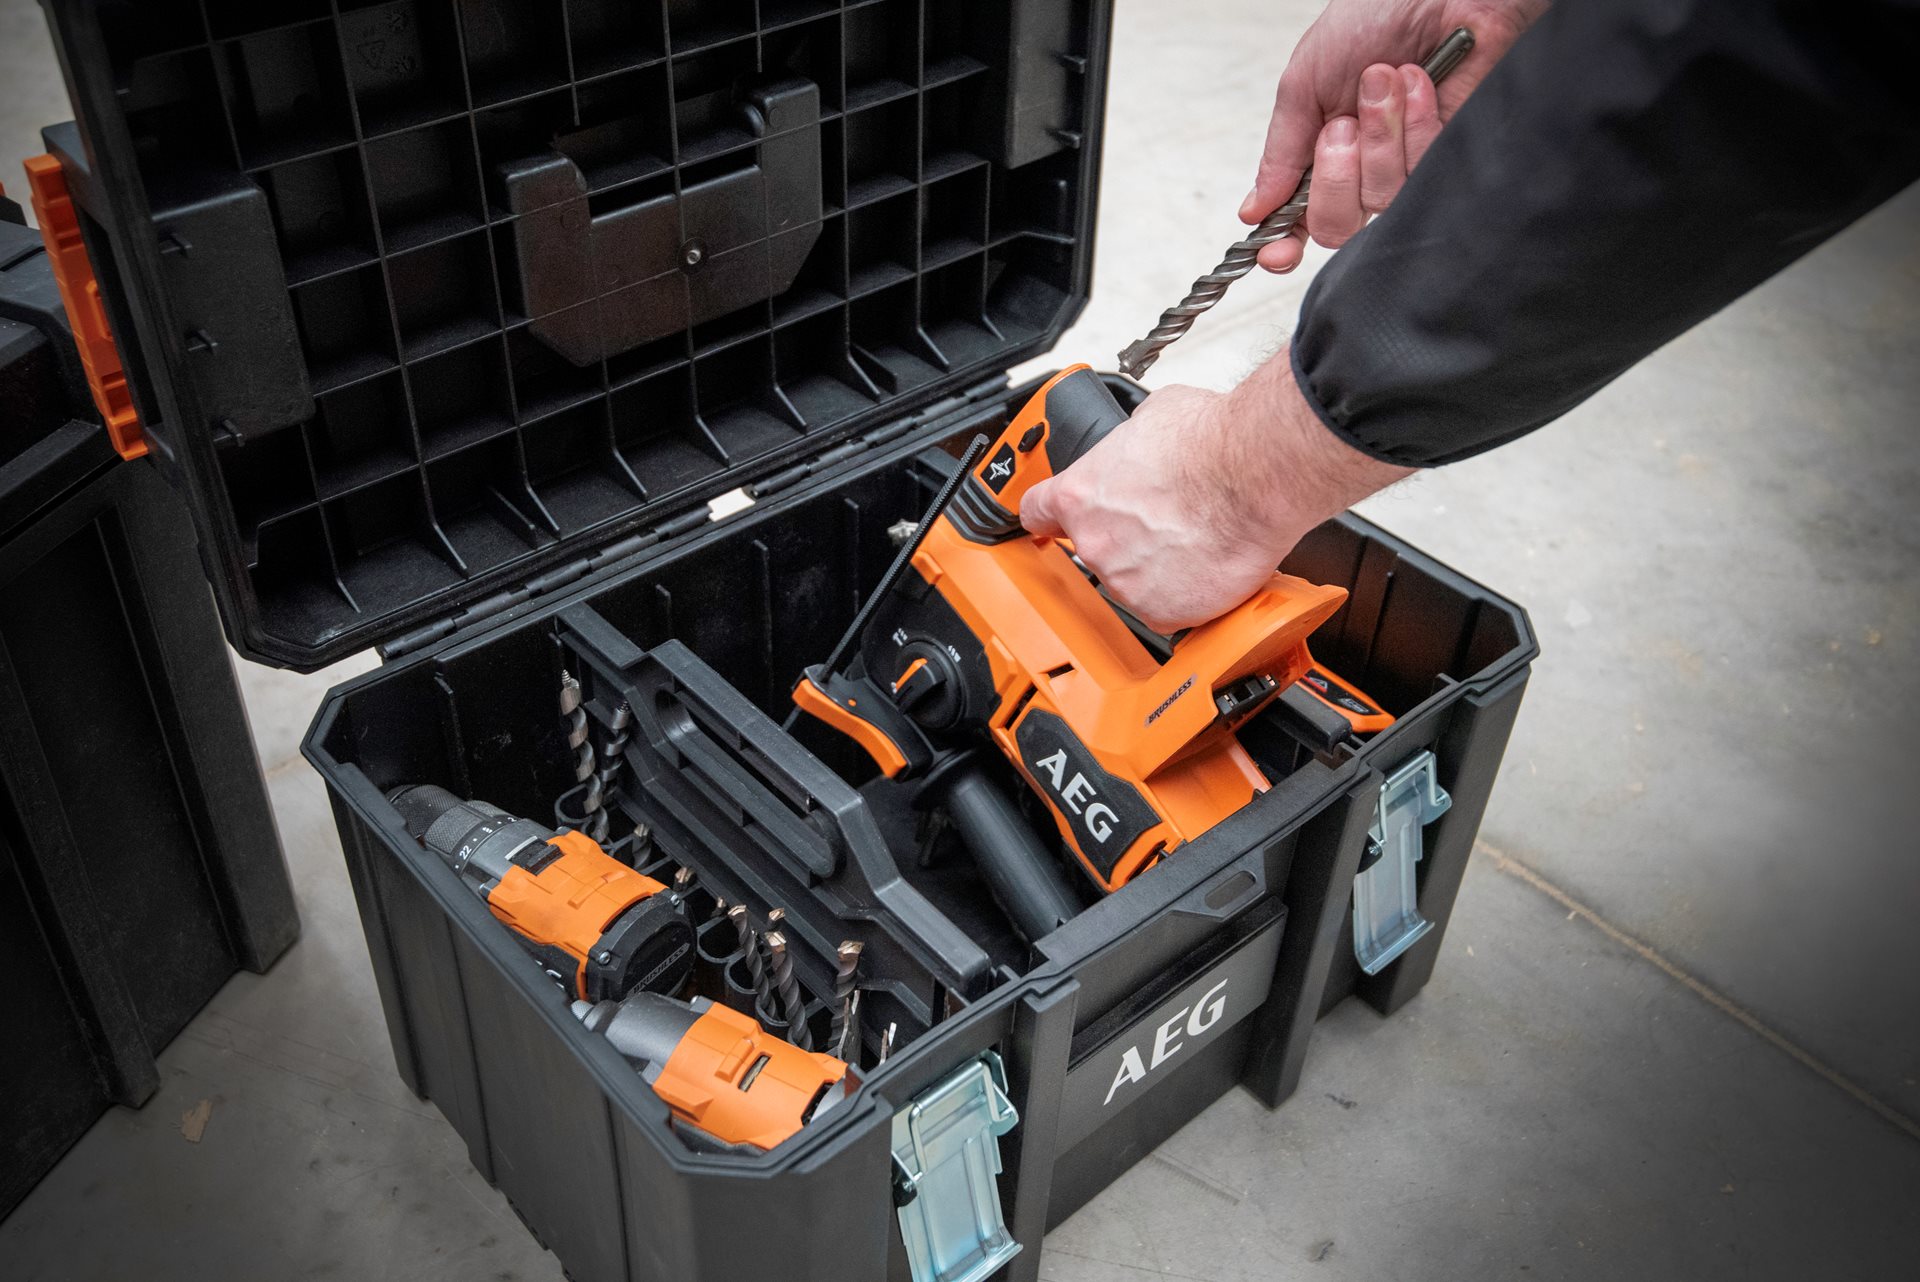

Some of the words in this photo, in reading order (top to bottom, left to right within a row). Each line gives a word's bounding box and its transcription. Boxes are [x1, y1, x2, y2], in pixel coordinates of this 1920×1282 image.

[1148, 678, 1192, 724] BRUSHLESS
[1036, 748, 1120, 843] AEG
[459, 845, 472, 860] 22
[1103, 978, 1228, 1106] AEG
